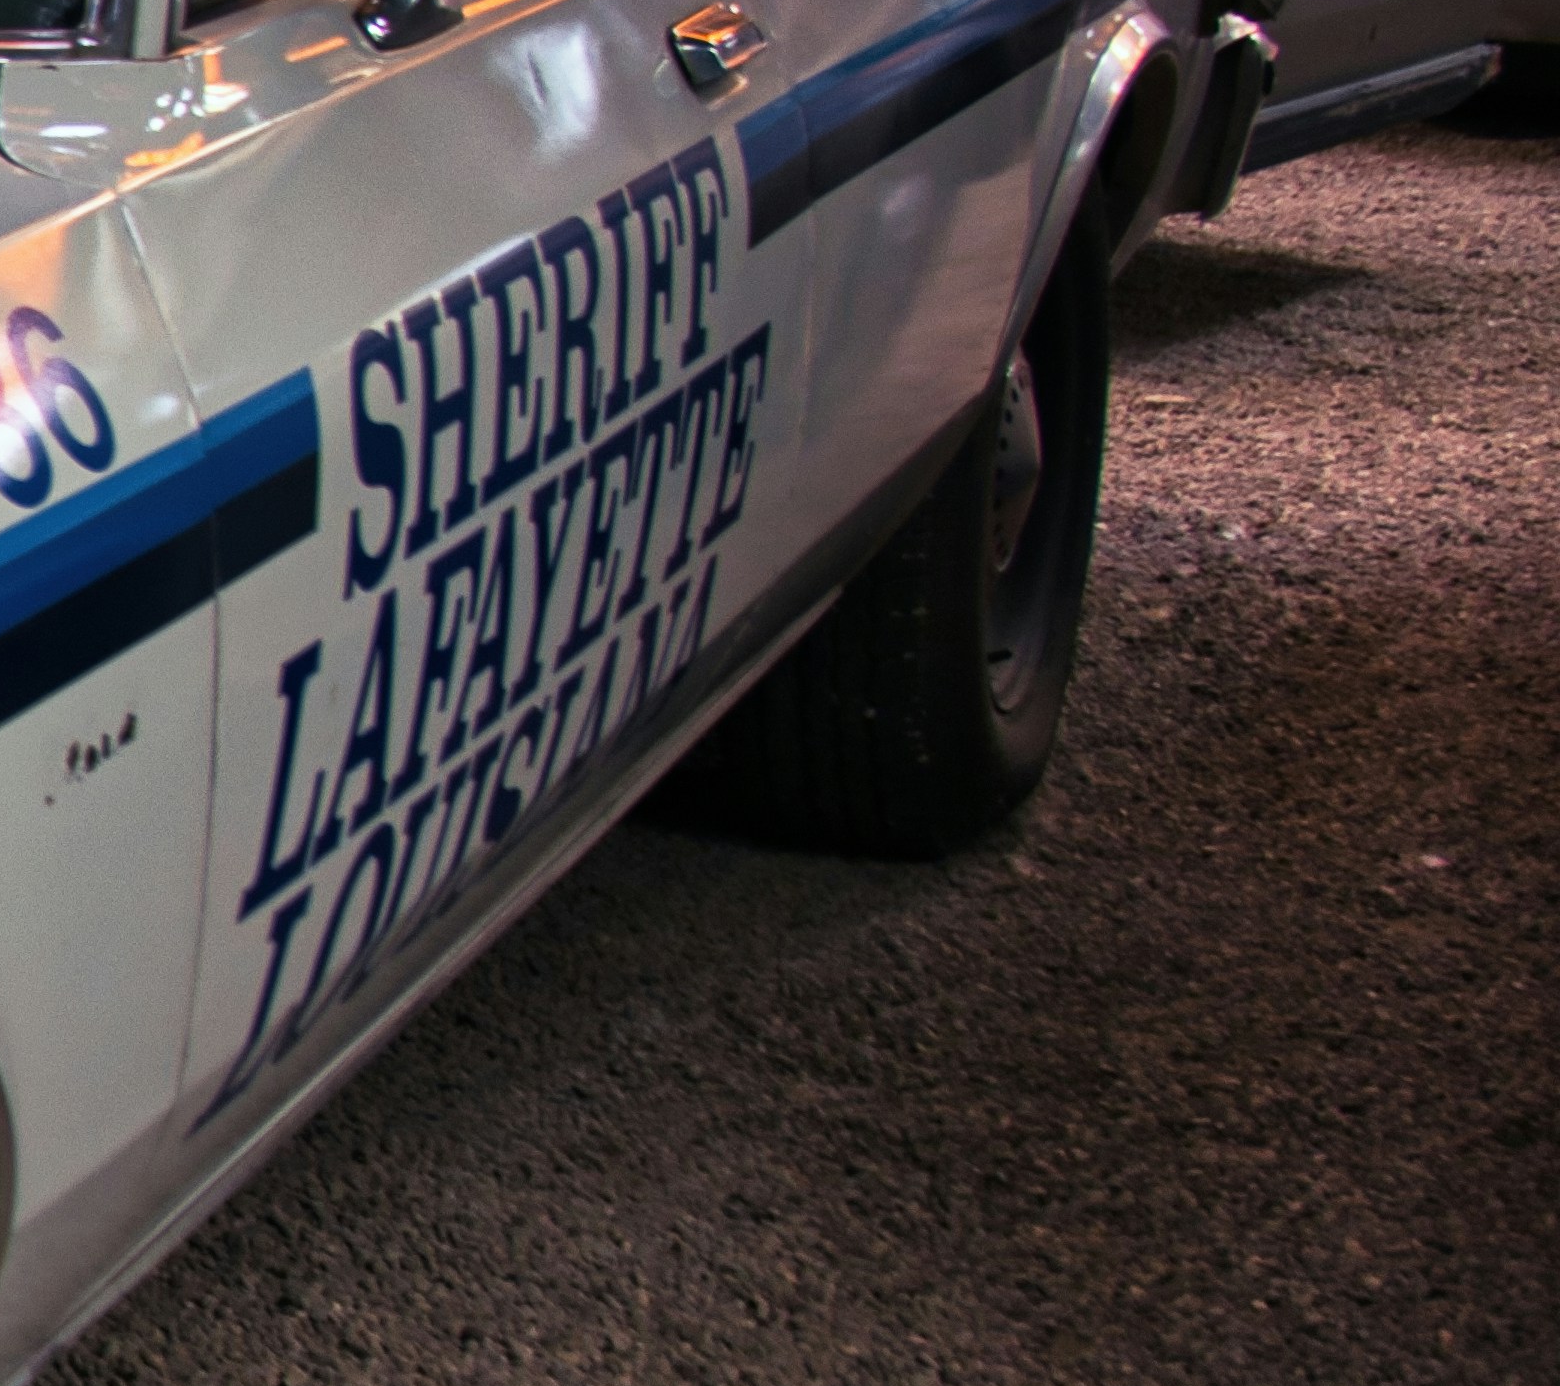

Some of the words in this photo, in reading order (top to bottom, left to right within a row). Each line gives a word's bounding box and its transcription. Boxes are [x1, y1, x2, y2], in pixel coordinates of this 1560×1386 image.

[236, 321, 773, 924] LAFAYETTE
[342, 136, 730, 600] SHERIFF
[186, 553, 724, 1137] LOUISIANA
